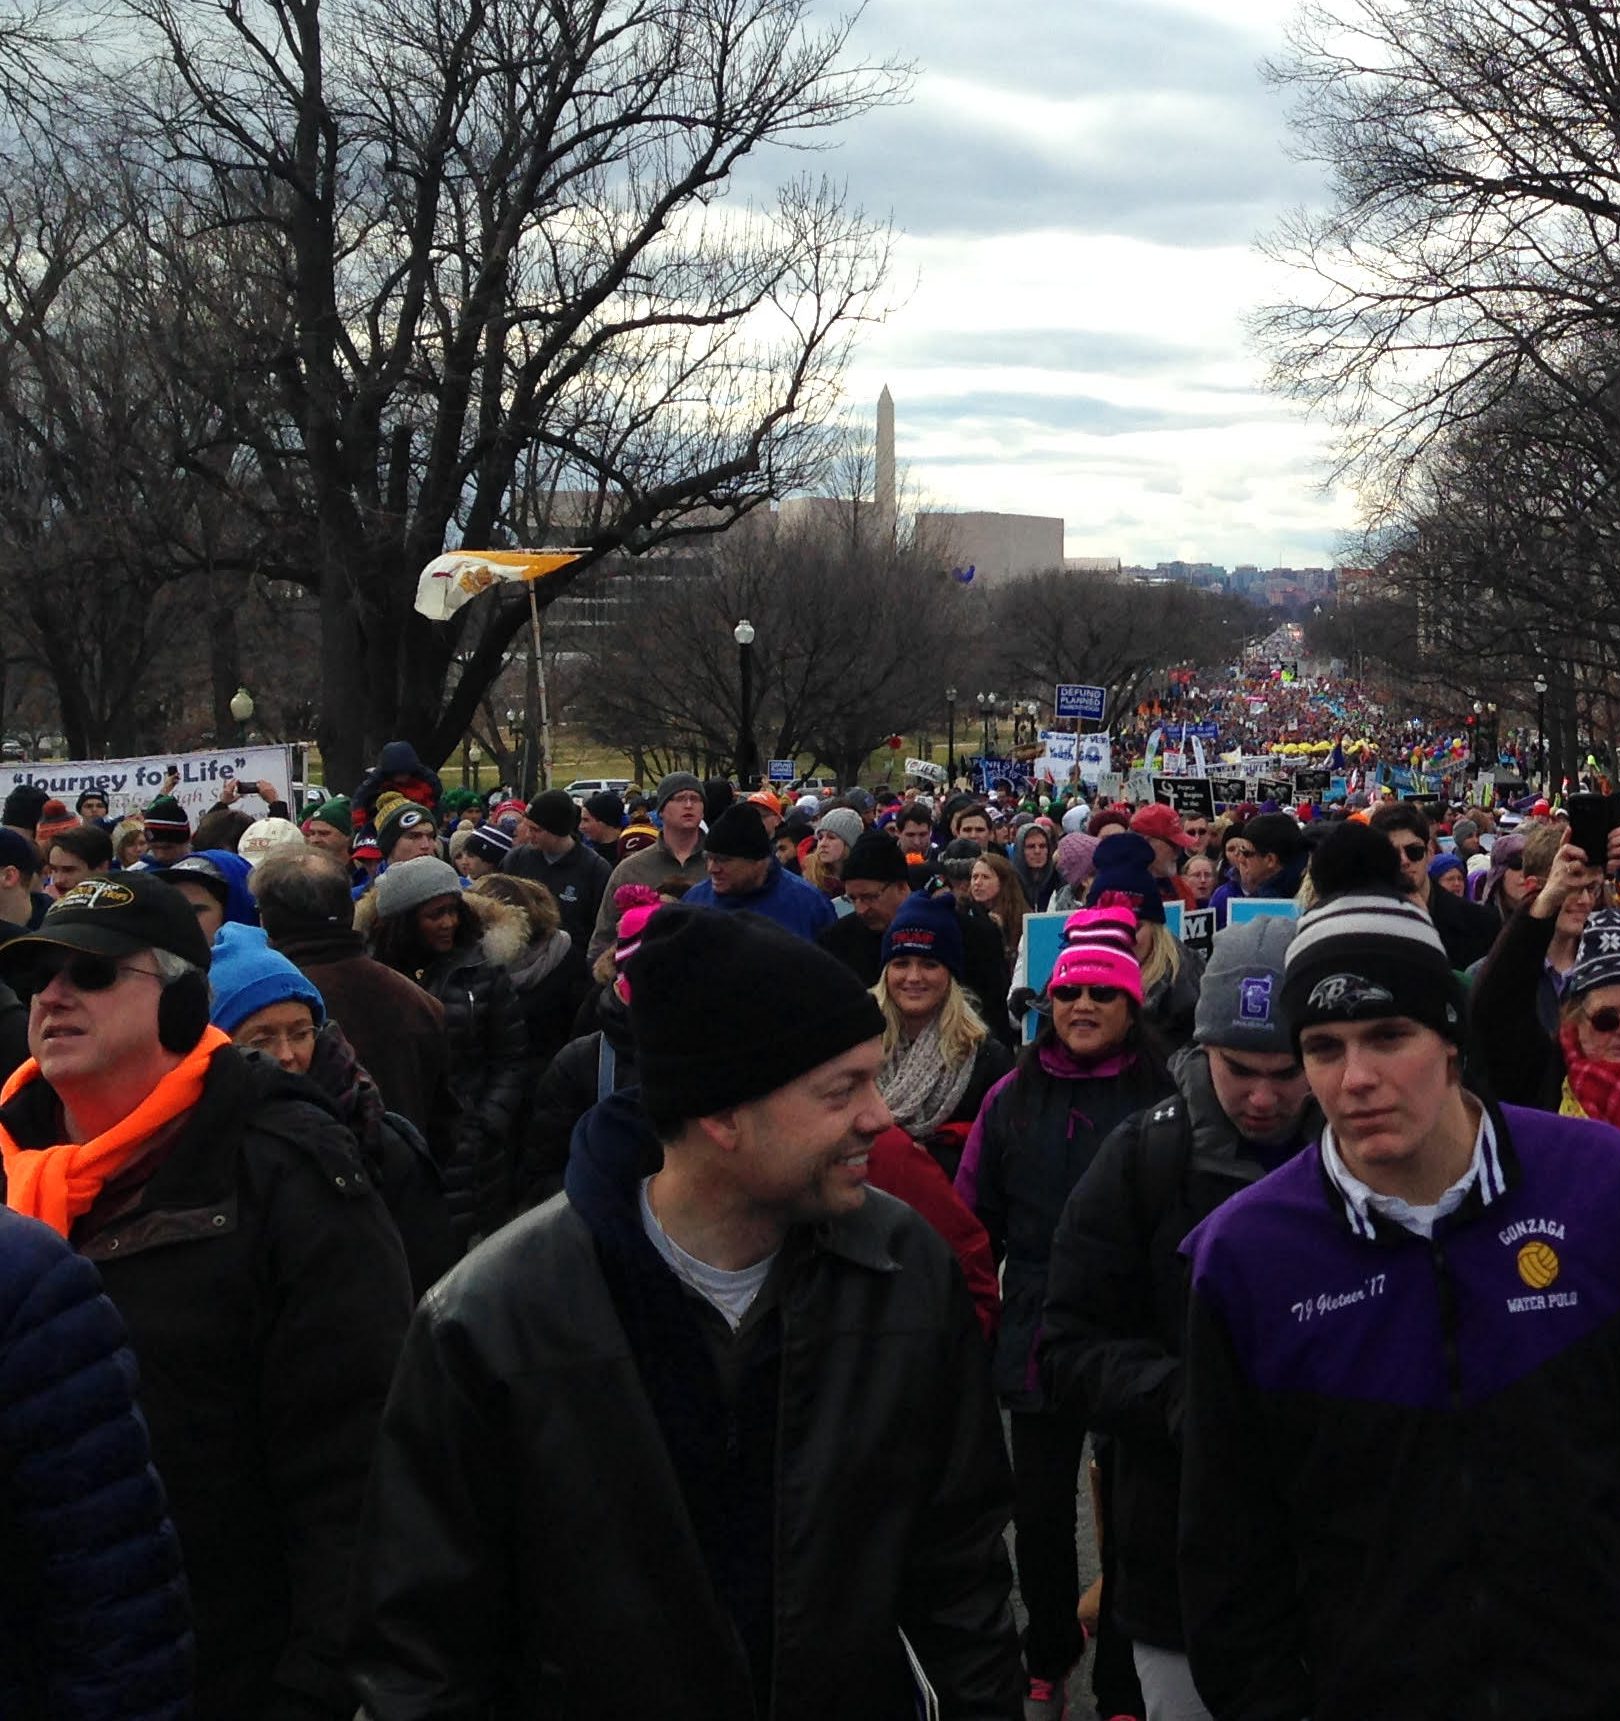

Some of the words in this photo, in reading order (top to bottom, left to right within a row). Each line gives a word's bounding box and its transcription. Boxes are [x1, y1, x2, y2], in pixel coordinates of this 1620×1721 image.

[1061, 687, 1101, 699] DEFUND
[1060, 697, 1101, 706] PLANNED
[625, 837, 640, 850] C
[1498, 1217, 1567, 1247] GONZAGA
[1506, 1295, 1546, 1314] WATER
[1548, 1291, 1579, 1309] POLO
